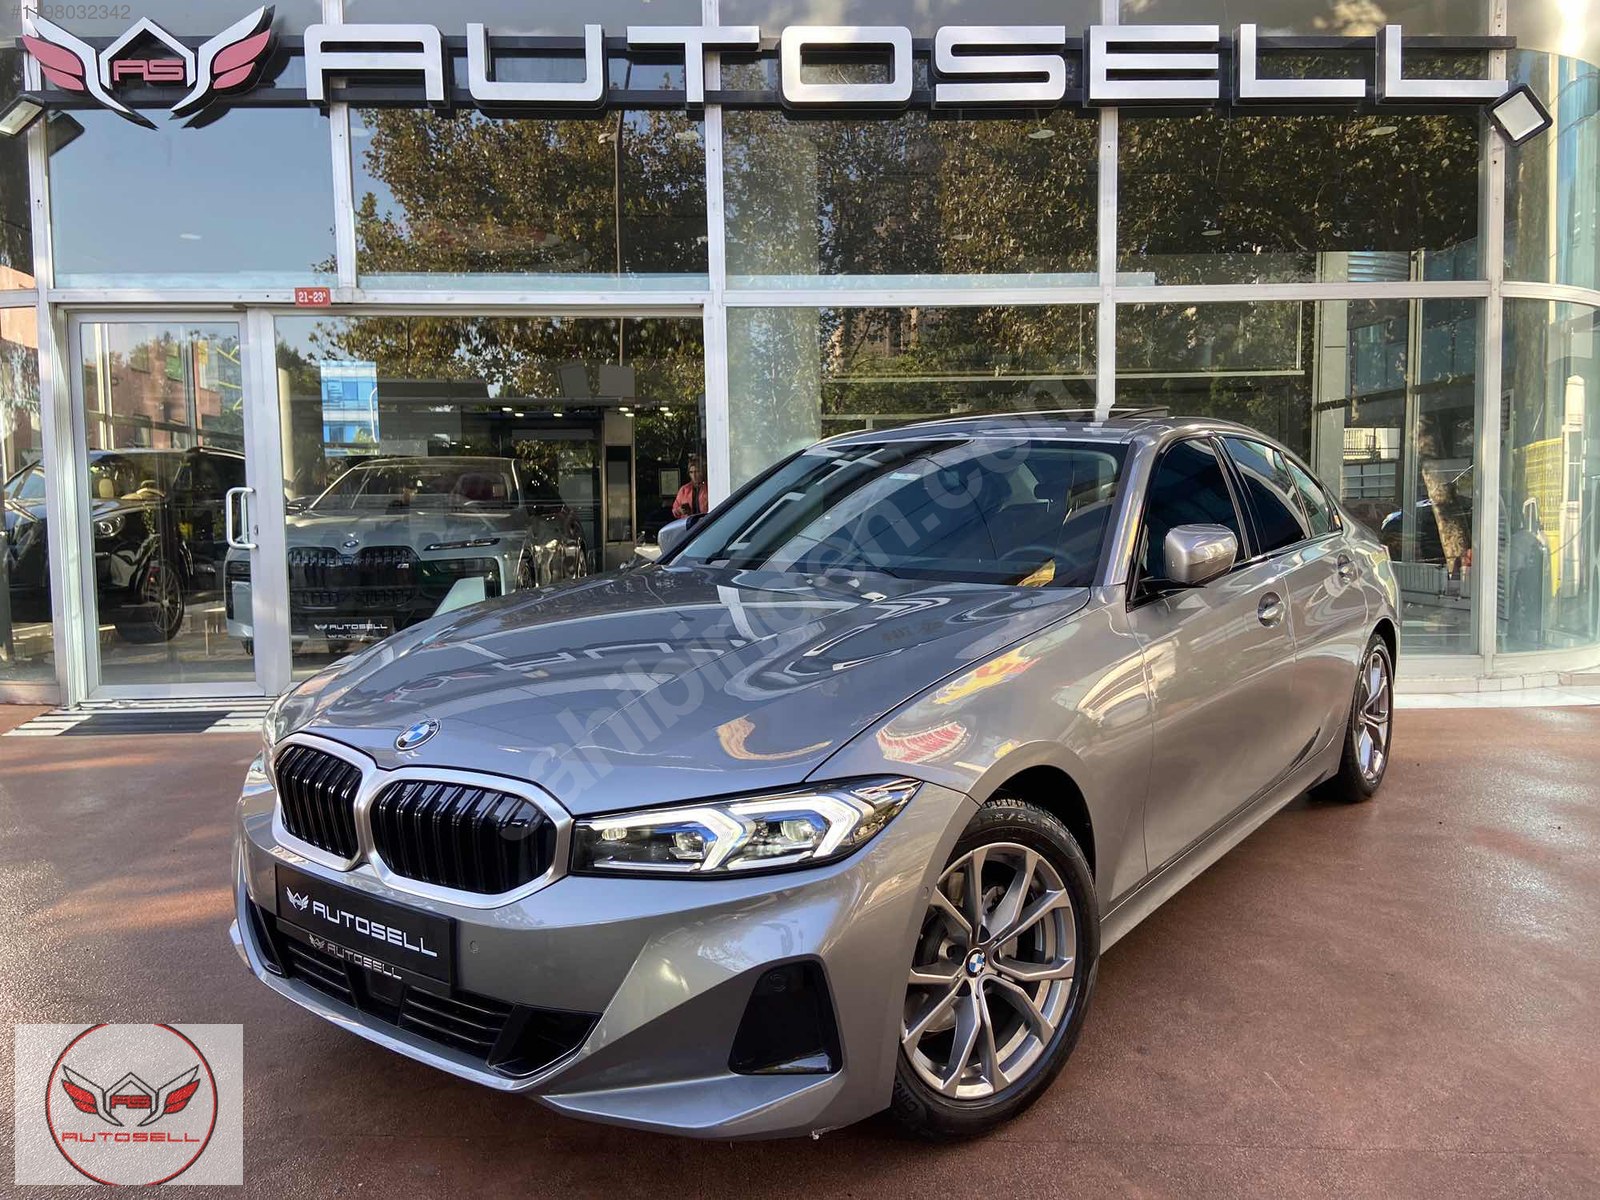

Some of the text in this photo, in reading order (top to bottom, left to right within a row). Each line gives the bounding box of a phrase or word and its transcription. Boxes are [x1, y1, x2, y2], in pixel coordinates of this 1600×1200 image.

[113, 59, 184, 81] AS
[305, 24, 1509, 104] AUTOSELL
[312, 900, 438, 958] AUTOSELL
[327, 942, 402, 980] AUTOSELL
